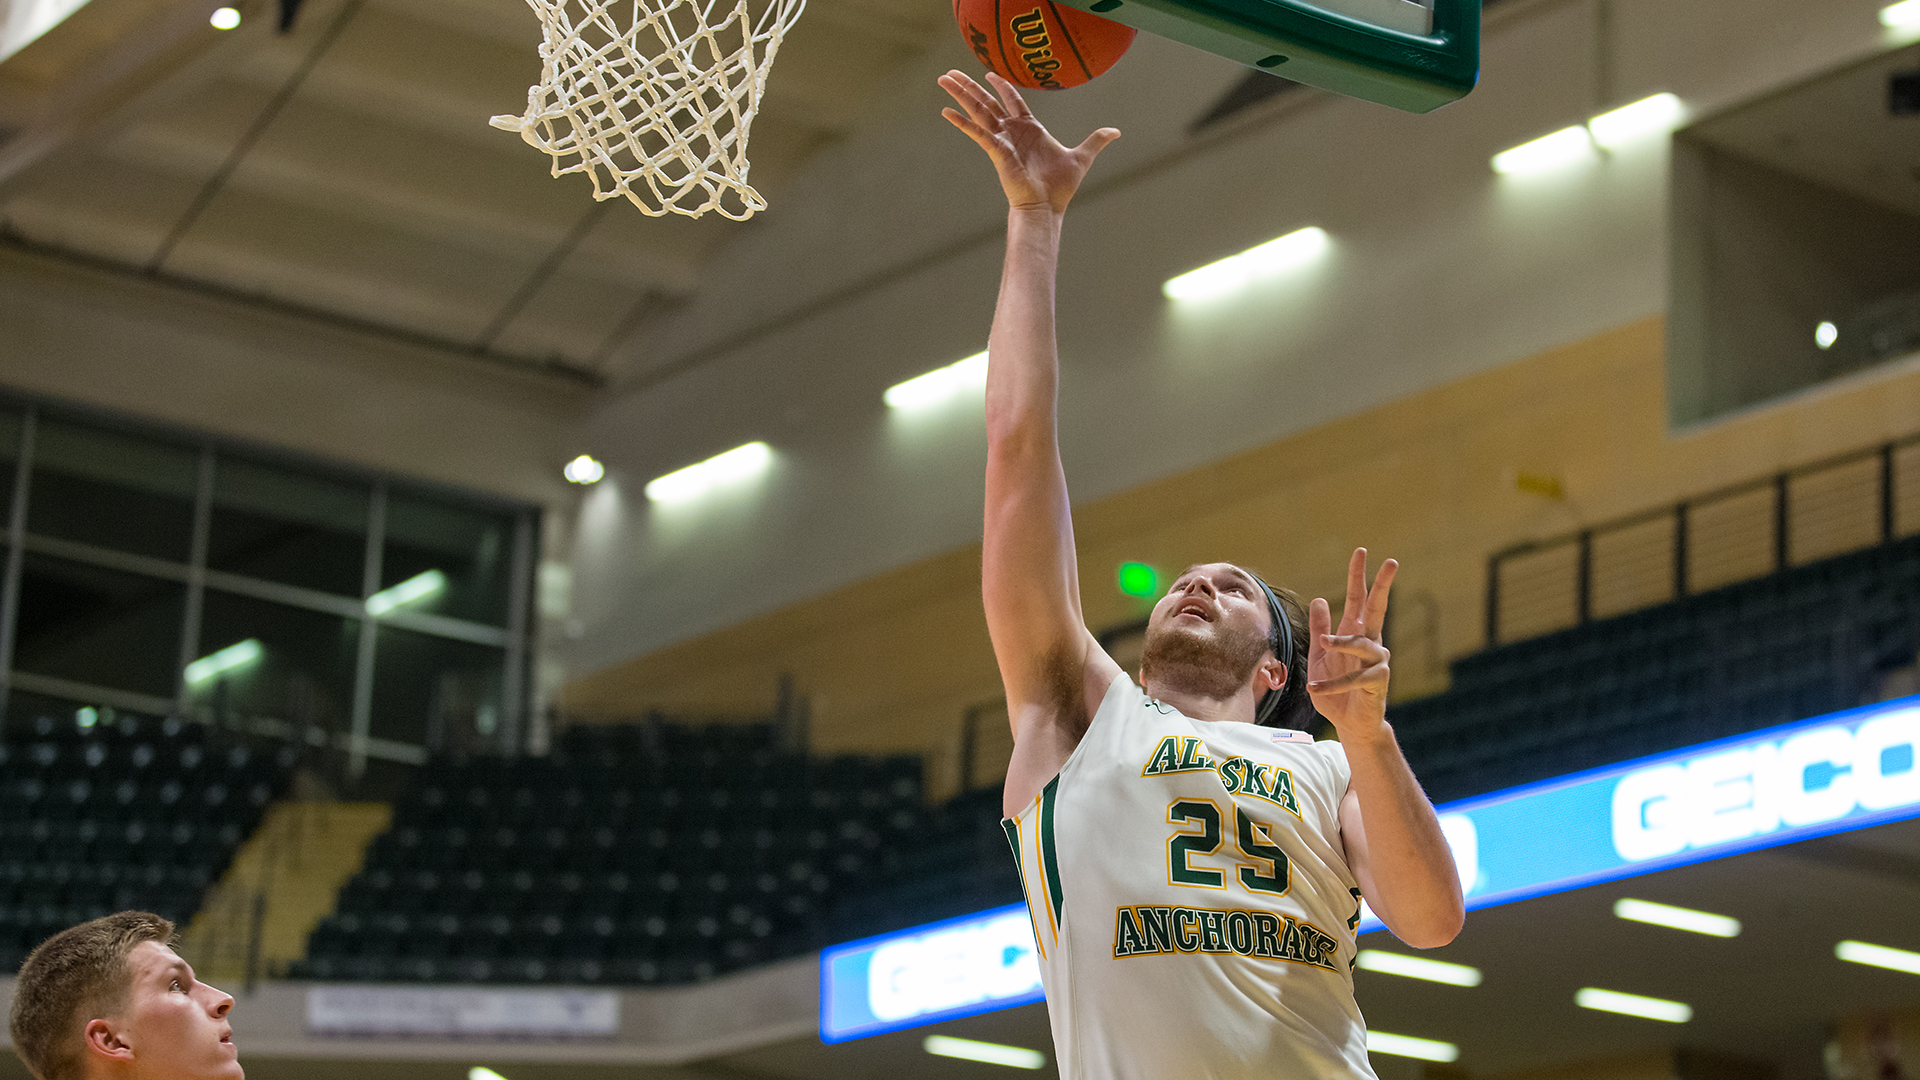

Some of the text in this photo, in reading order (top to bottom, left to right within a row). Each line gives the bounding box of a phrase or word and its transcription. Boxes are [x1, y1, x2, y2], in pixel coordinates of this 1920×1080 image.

[1009, 6, 1066, 91] Wilso
[1140, 735, 1303, 822] ALSKA
[1612, 707, 1920, 862] GEICO
[1165, 797, 1293, 897] 25
[868, 912, 1044, 1022] GEIC
